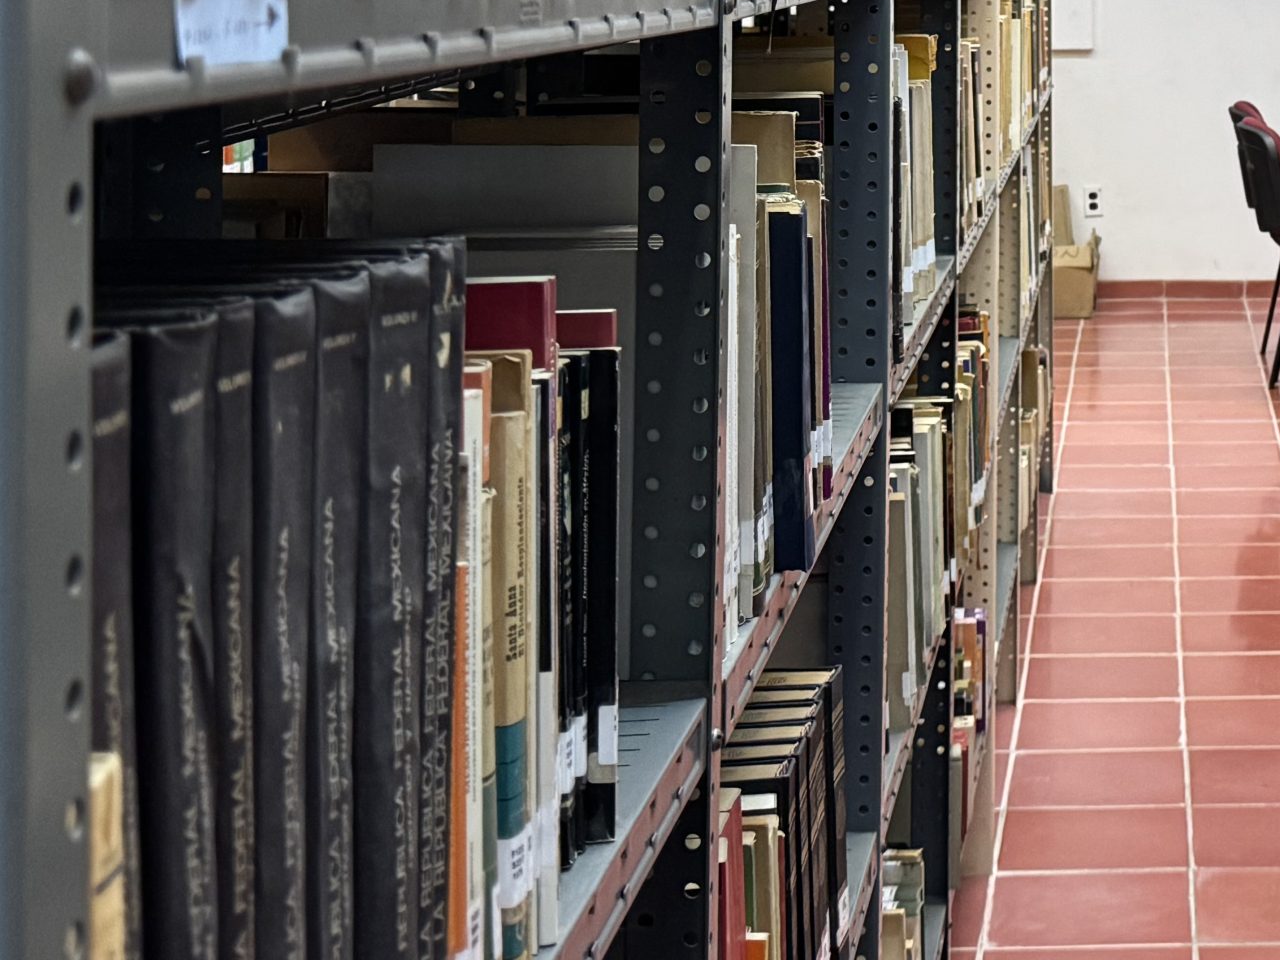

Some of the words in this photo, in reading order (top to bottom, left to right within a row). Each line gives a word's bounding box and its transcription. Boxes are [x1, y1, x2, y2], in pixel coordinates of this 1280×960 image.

[391, 465, 404, 622] MEXICANA
[427, 442, 440, 592] MEXICANA
[441, 428, 453, 576] MEXICANA
[436, 590, 450, 715] FEDERAL
[504, 585, 517, 618] Anna
[505, 624, 517, 662] Santa
[517, 584, 525, 637] Dictador
[393, 637, 404, 770] FEDERAL
[424, 606, 436, 734] FEDERAL
[420, 748, 433, 908] REPUBLICA
[434, 730, 447, 886] REPUBLICA
